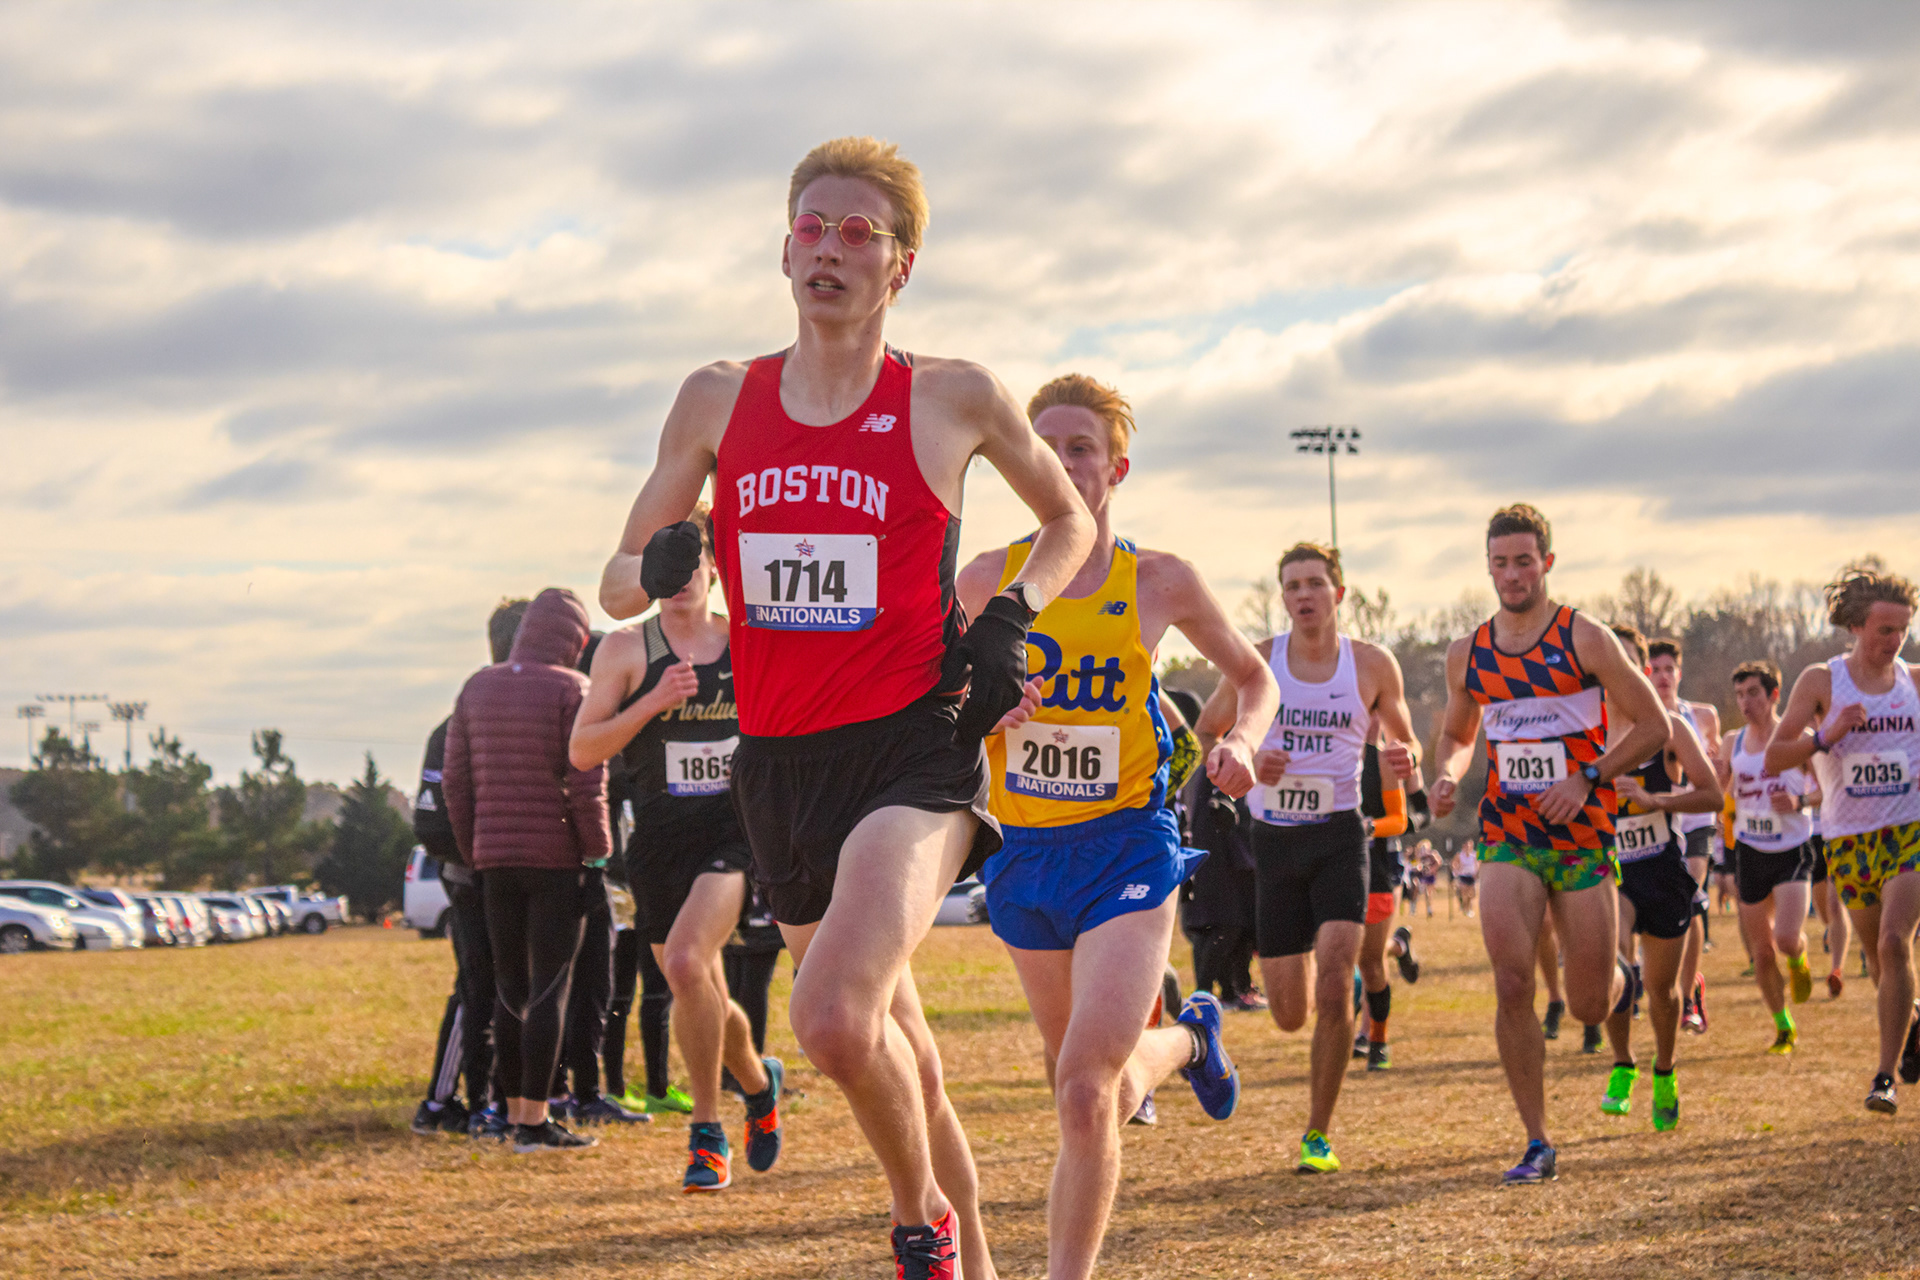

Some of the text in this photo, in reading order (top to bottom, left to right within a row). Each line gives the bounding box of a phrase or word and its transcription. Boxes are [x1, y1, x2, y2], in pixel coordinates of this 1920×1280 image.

[736, 464, 889, 522] BOSTON
[764, 559, 848, 603] 1714
[760, 606, 861, 625] NATIONALS
[1275, 703, 1352, 729] MICHIGAN
[1851, 716, 1915, 733] GINIA
[1283, 730, 1334, 753] STATE
[679, 754, 732, 781] 1865
[1022, 740, 1102, 781] 2016
[1506, 757, 1555, 779] 2031
[1852, 762, 1902, 785] 2035
[1021, 777, 1106, 798] NATIONALS
[1506, 782, 1552, 792] NATIONAL
[1278, 789, 1320, 811] 1779
[1617, 825, 1656, 850] 1971
